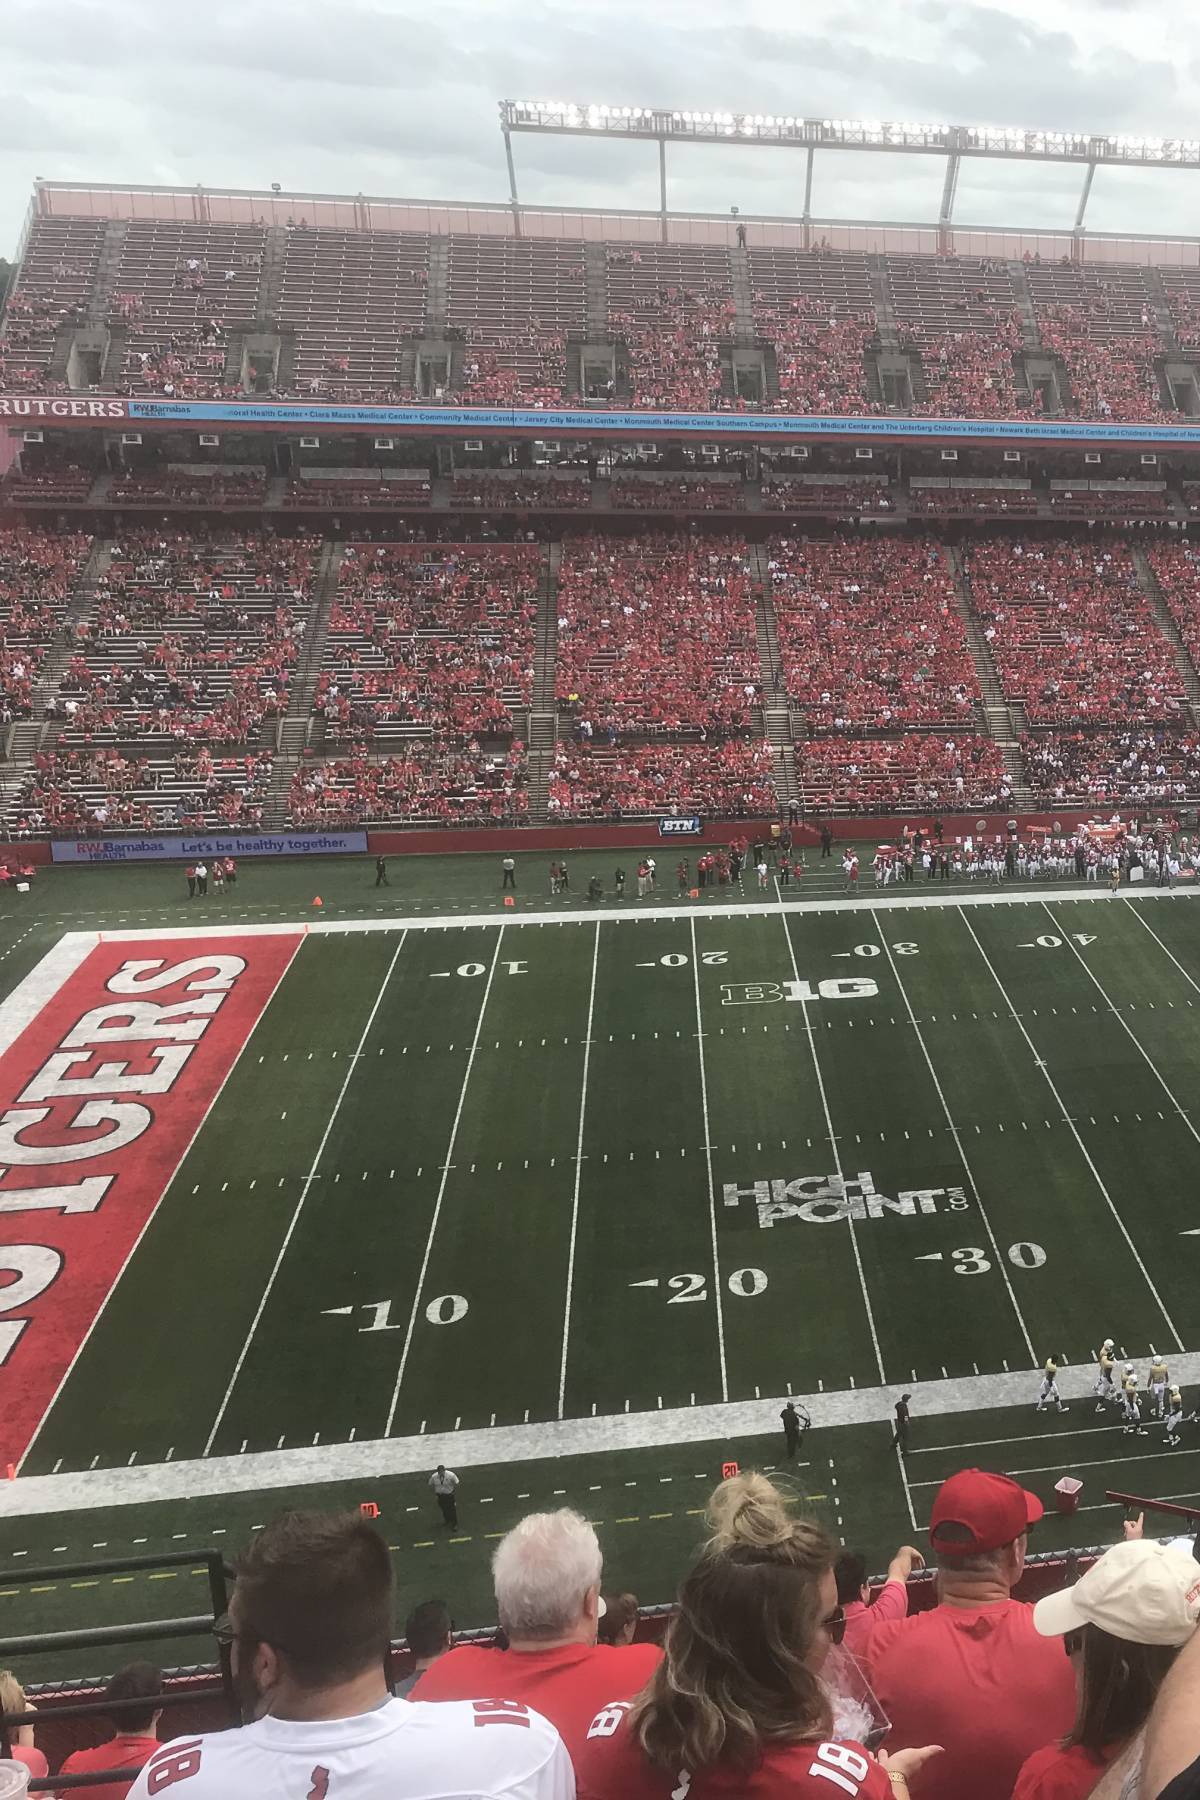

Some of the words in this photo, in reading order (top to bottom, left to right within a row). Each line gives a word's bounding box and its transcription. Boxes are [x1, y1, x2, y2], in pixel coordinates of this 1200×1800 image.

[0, 400, 125, 416] RUTGERS
[419, 413, 461, 421] Community
[524, 415, 547, 423] Jersey
[550, 416, 563, 424] City
[750, 421, 777, 429] Campus
[968, 426, 994, 434] Hospital
[662, 820, 694, 831] BTN
[182, 842, 212, 852] Let's
[216, 841, 233, 851] be
[236, 839, 284, 853] healthy
[288, 837, 347, 851] together.
[1036, 933, 1098, 948] 40
[854, 942, 920, 957] 30
[660, 951, 728, 967] 20
[456, 960, 529, 977] 10
[723, 1171, 876, 1207] HIGH
[757, 1188, 945, 1229] POINT
[950, 1241, 1048, 1275] 30
[666, 1268, 769, 1304] 20
[358, 1294, 469, 1333] 10
[724, 1464, 737, 1479] 20
[808, 1742, 869, 1798] 18
